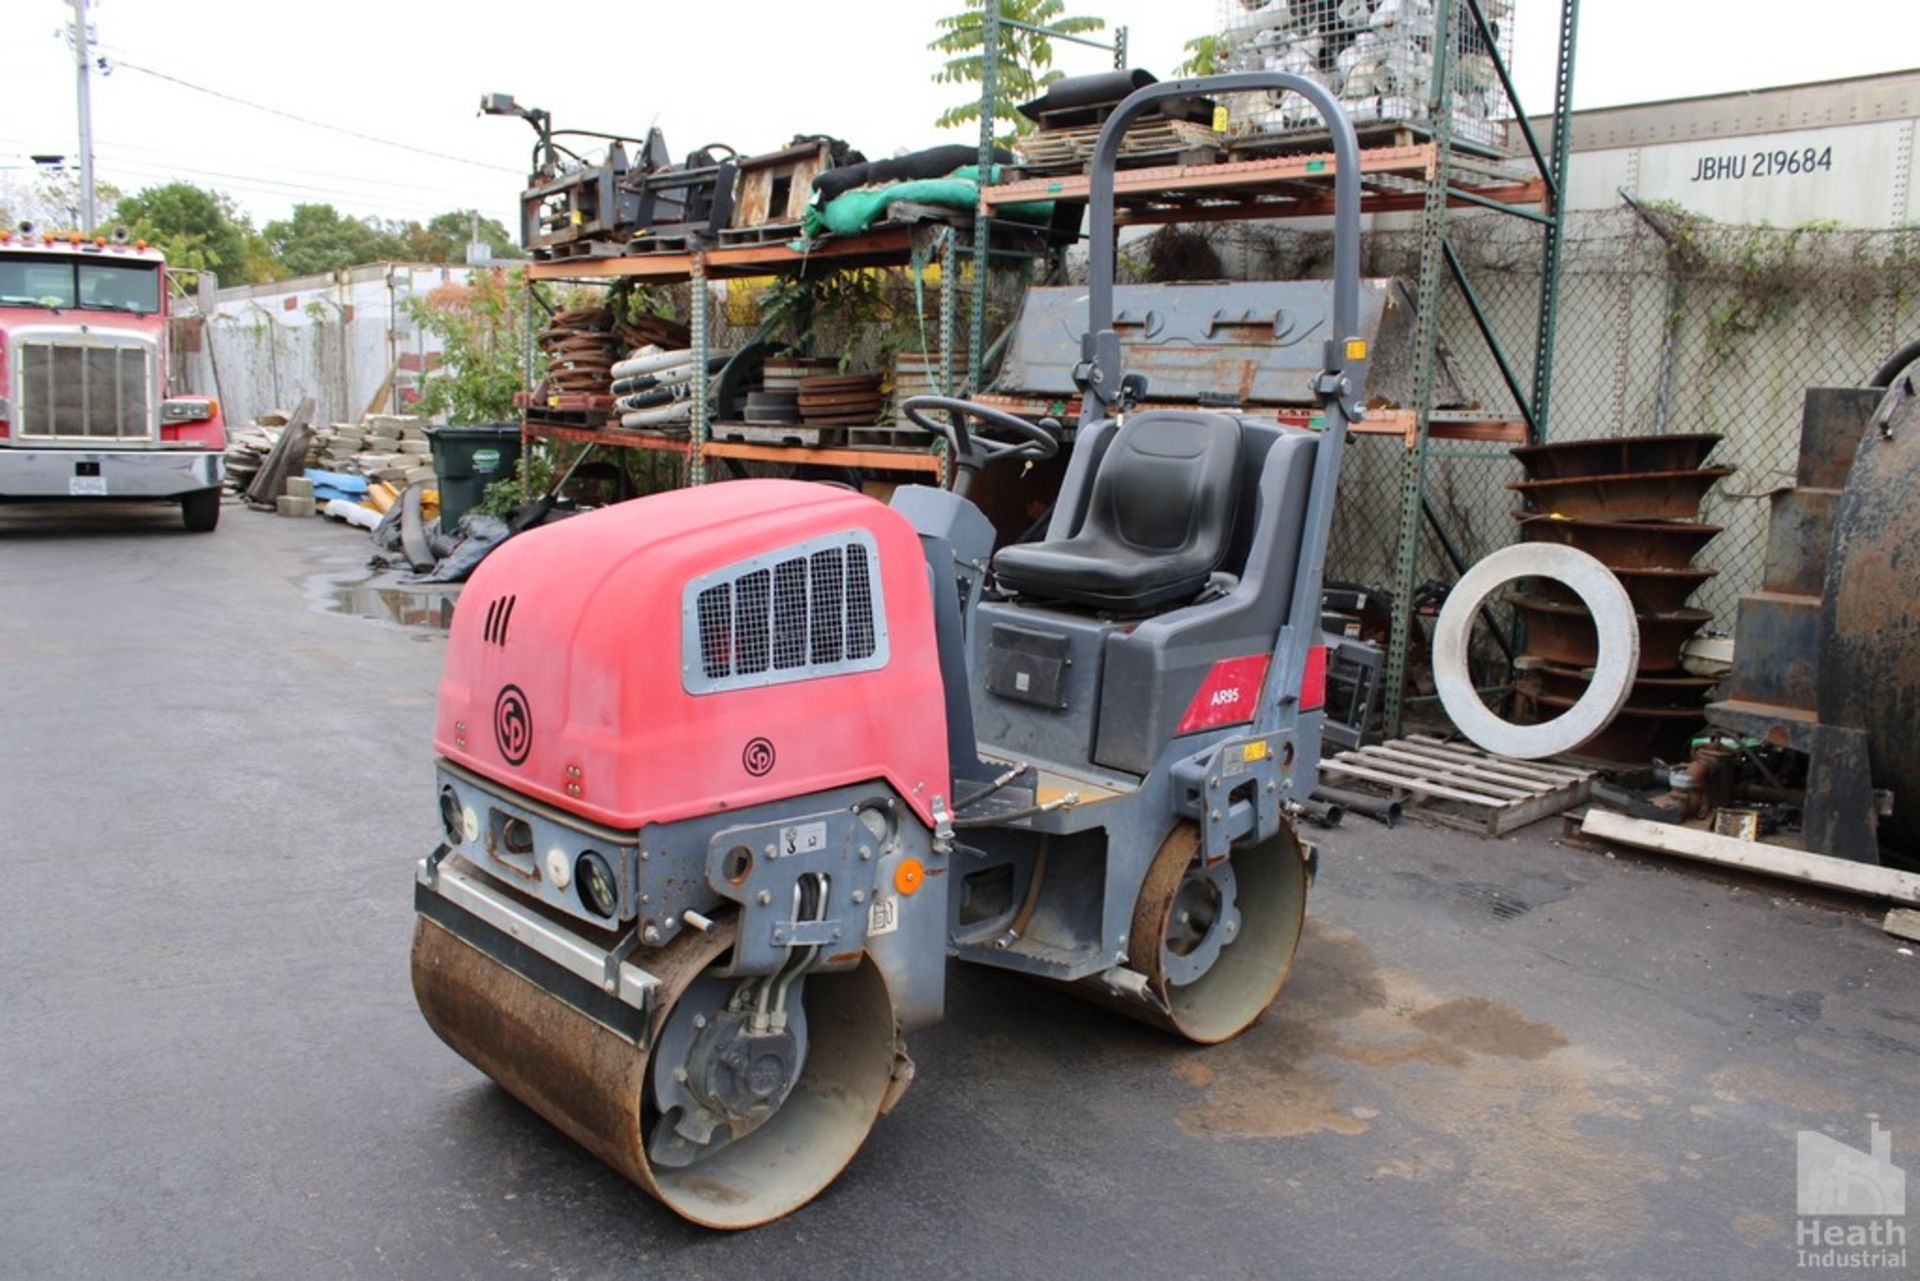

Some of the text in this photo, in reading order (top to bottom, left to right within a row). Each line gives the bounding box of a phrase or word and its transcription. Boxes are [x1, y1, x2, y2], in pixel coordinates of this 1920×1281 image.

[1691, 146, 1832, 182] JBHU 219684
[1210, 687, 1239, 706] AR95
